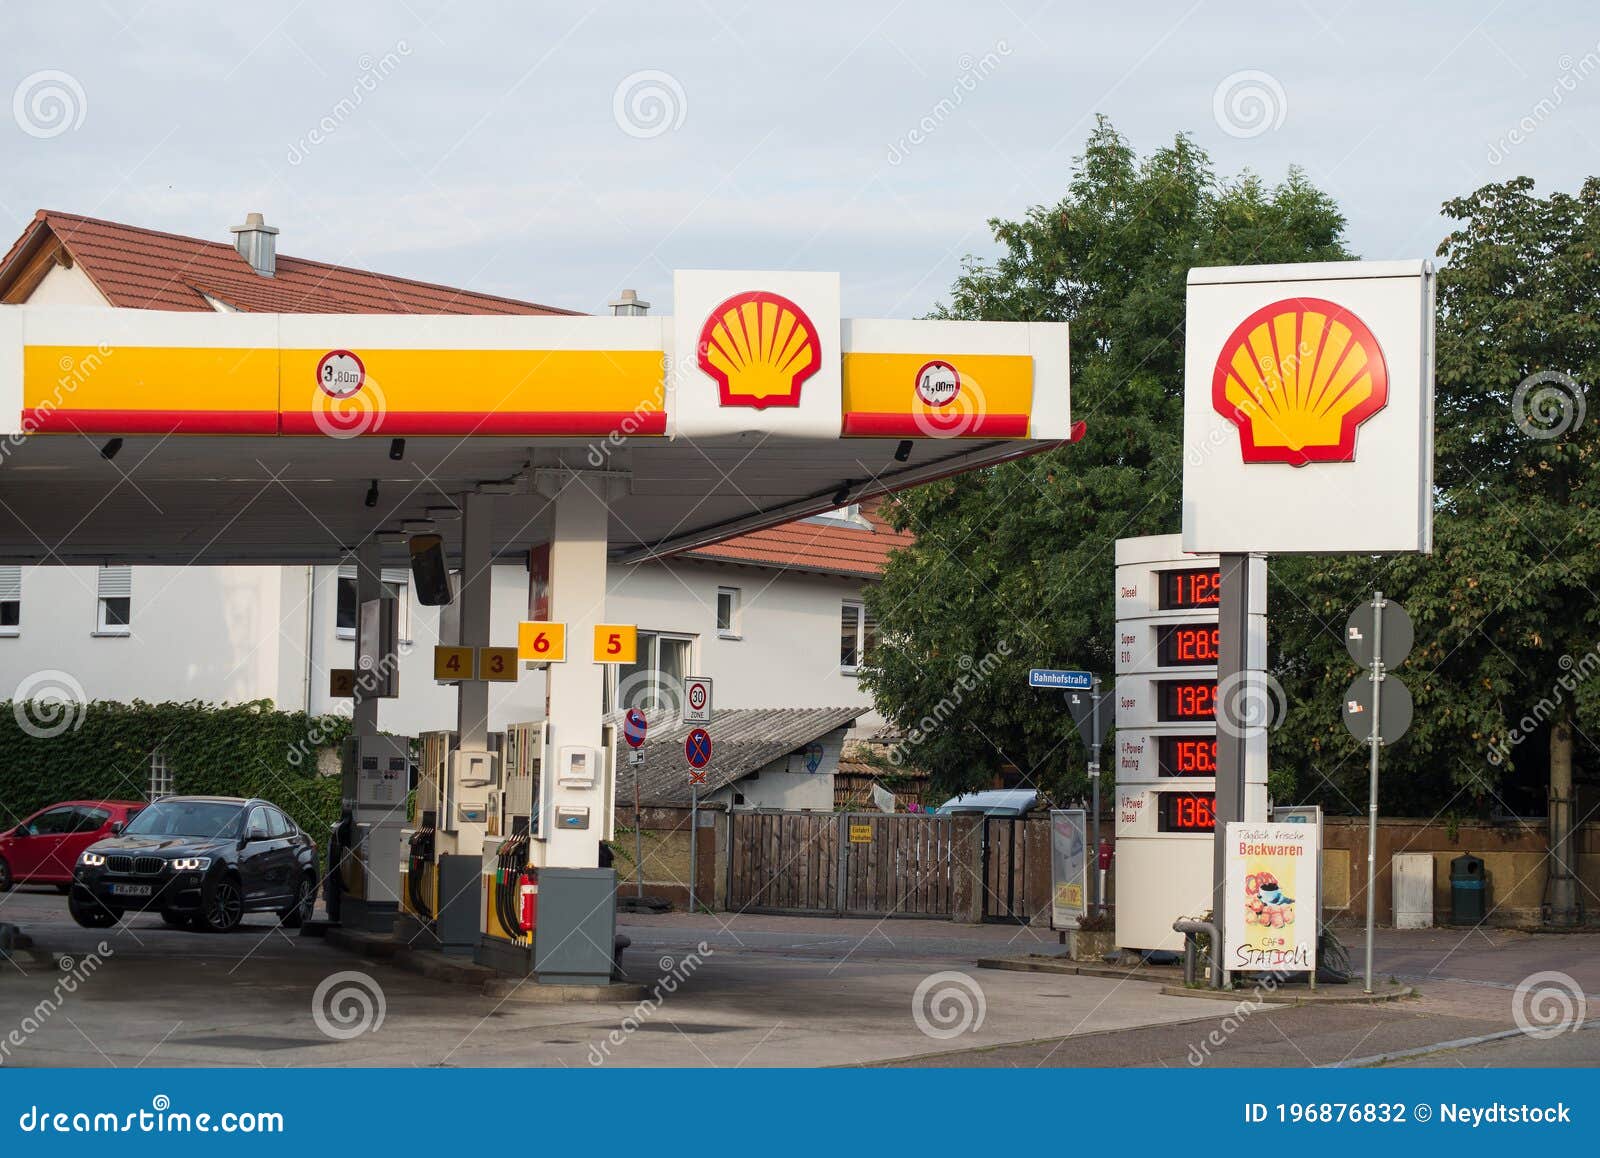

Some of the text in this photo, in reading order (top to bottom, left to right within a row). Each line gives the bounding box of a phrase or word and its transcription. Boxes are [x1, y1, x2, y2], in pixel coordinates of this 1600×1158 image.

[324, 365, 359, 385] 3,80m
[922, 375, 955, 394] 4,00m
[1121, 585, 1137, 598] Diesel
[533, 632, 550, 652] 6
[606, 634, 622, 654] 5
[1121, 632, 1136, 646] Super
[446, 655, 460, 672] 4
[491, 655, 504, 673] 3
[1121, 651, 1131, 663] E10
[336, 675, 348, 691] 2
[1034, 672, 1088, 684] Bahnhofstraße
[692, 690, 703, 703] 30
[1121, 697, 1136, 710] Super
[690, 711, 704, 719] ZONE
[1121, 742, 1144, 754] V-Power
[1121, 757, 1139, 771] Racing
[1121, 797, 1144, 809] V-Power
[1121, 811, 1137, 823] Diesel
[1239, 842, 1303, 857] Backwaren
[1236, 942, 1310, 968] STATION
